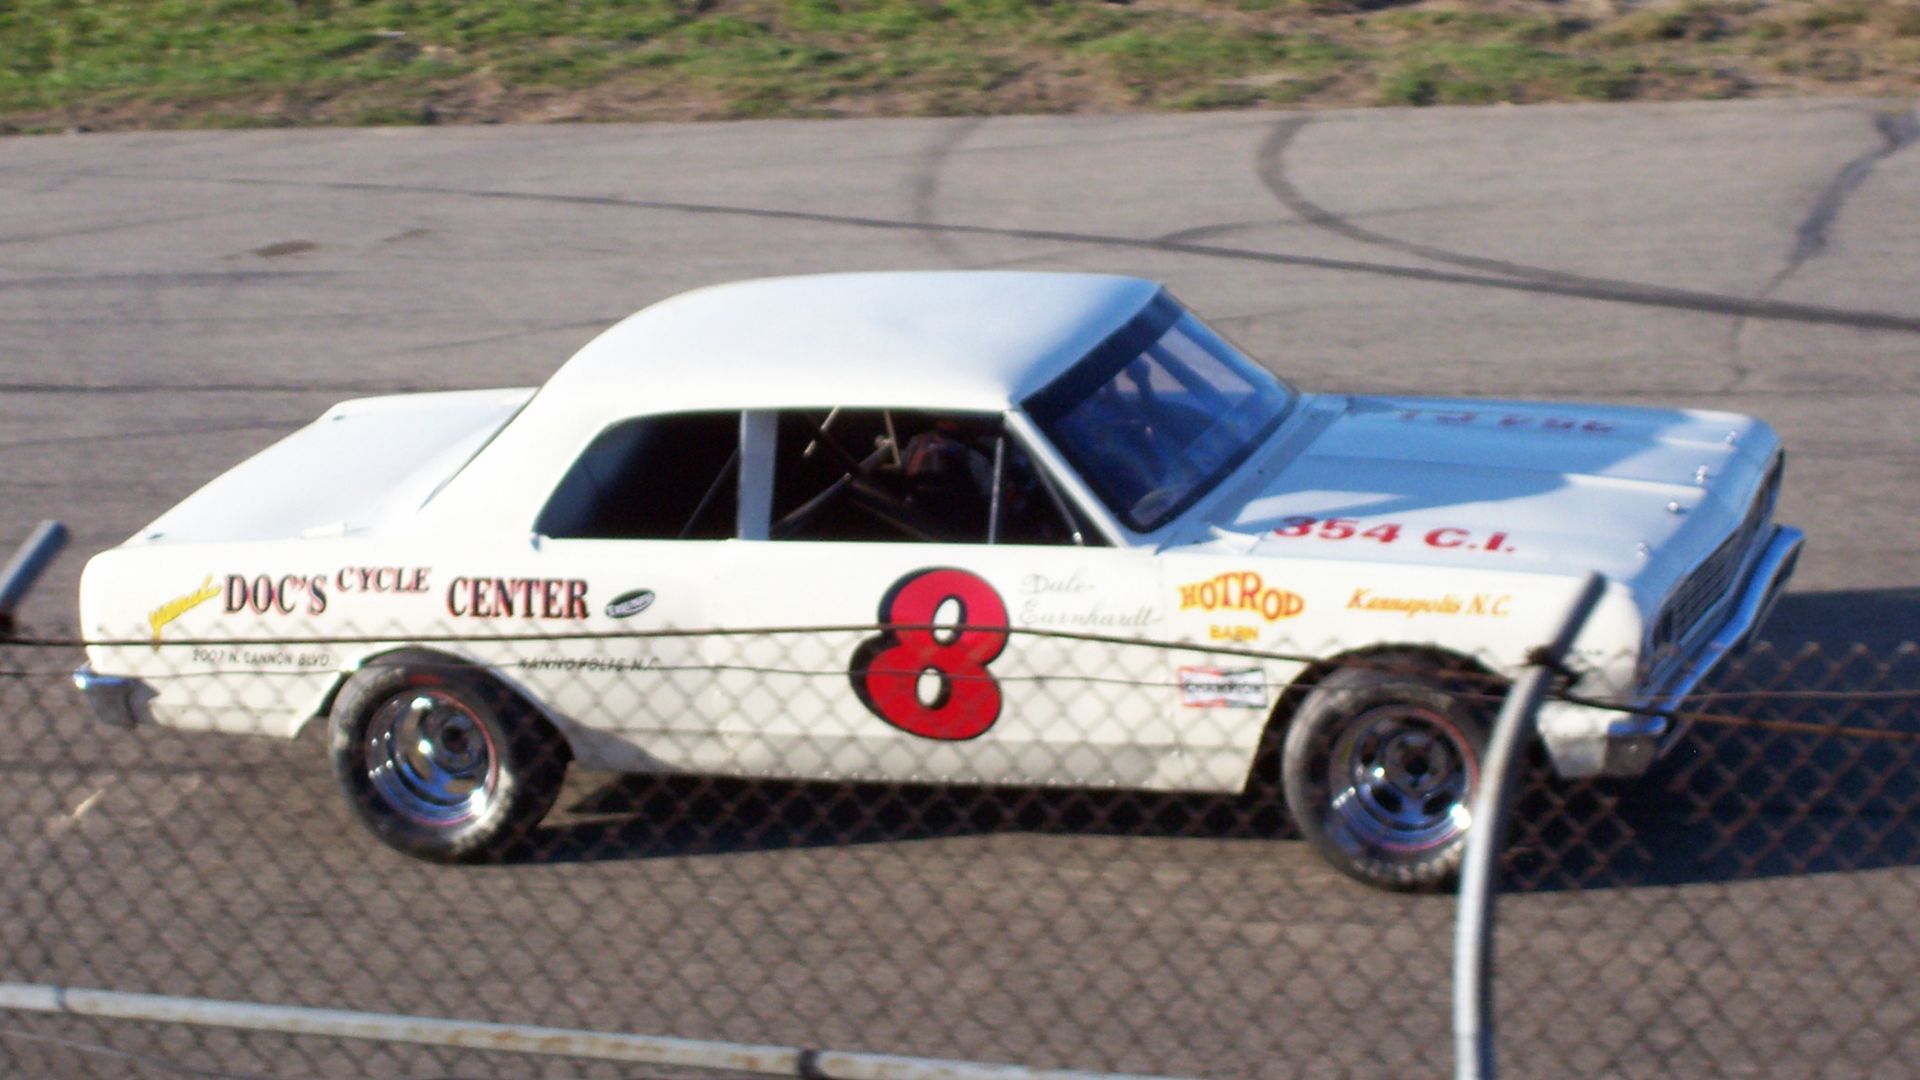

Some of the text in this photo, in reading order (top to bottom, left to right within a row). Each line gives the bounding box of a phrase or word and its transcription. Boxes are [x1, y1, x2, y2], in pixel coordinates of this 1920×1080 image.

[1274, 515, 1516, 553] 354 C.I.
[223, 574, 329, 616] DOC'S
[336, 567, 432, 593] CYCLE
[447, 576, 590, 620] CENTER
[849, 566, 1009, 741] 8
